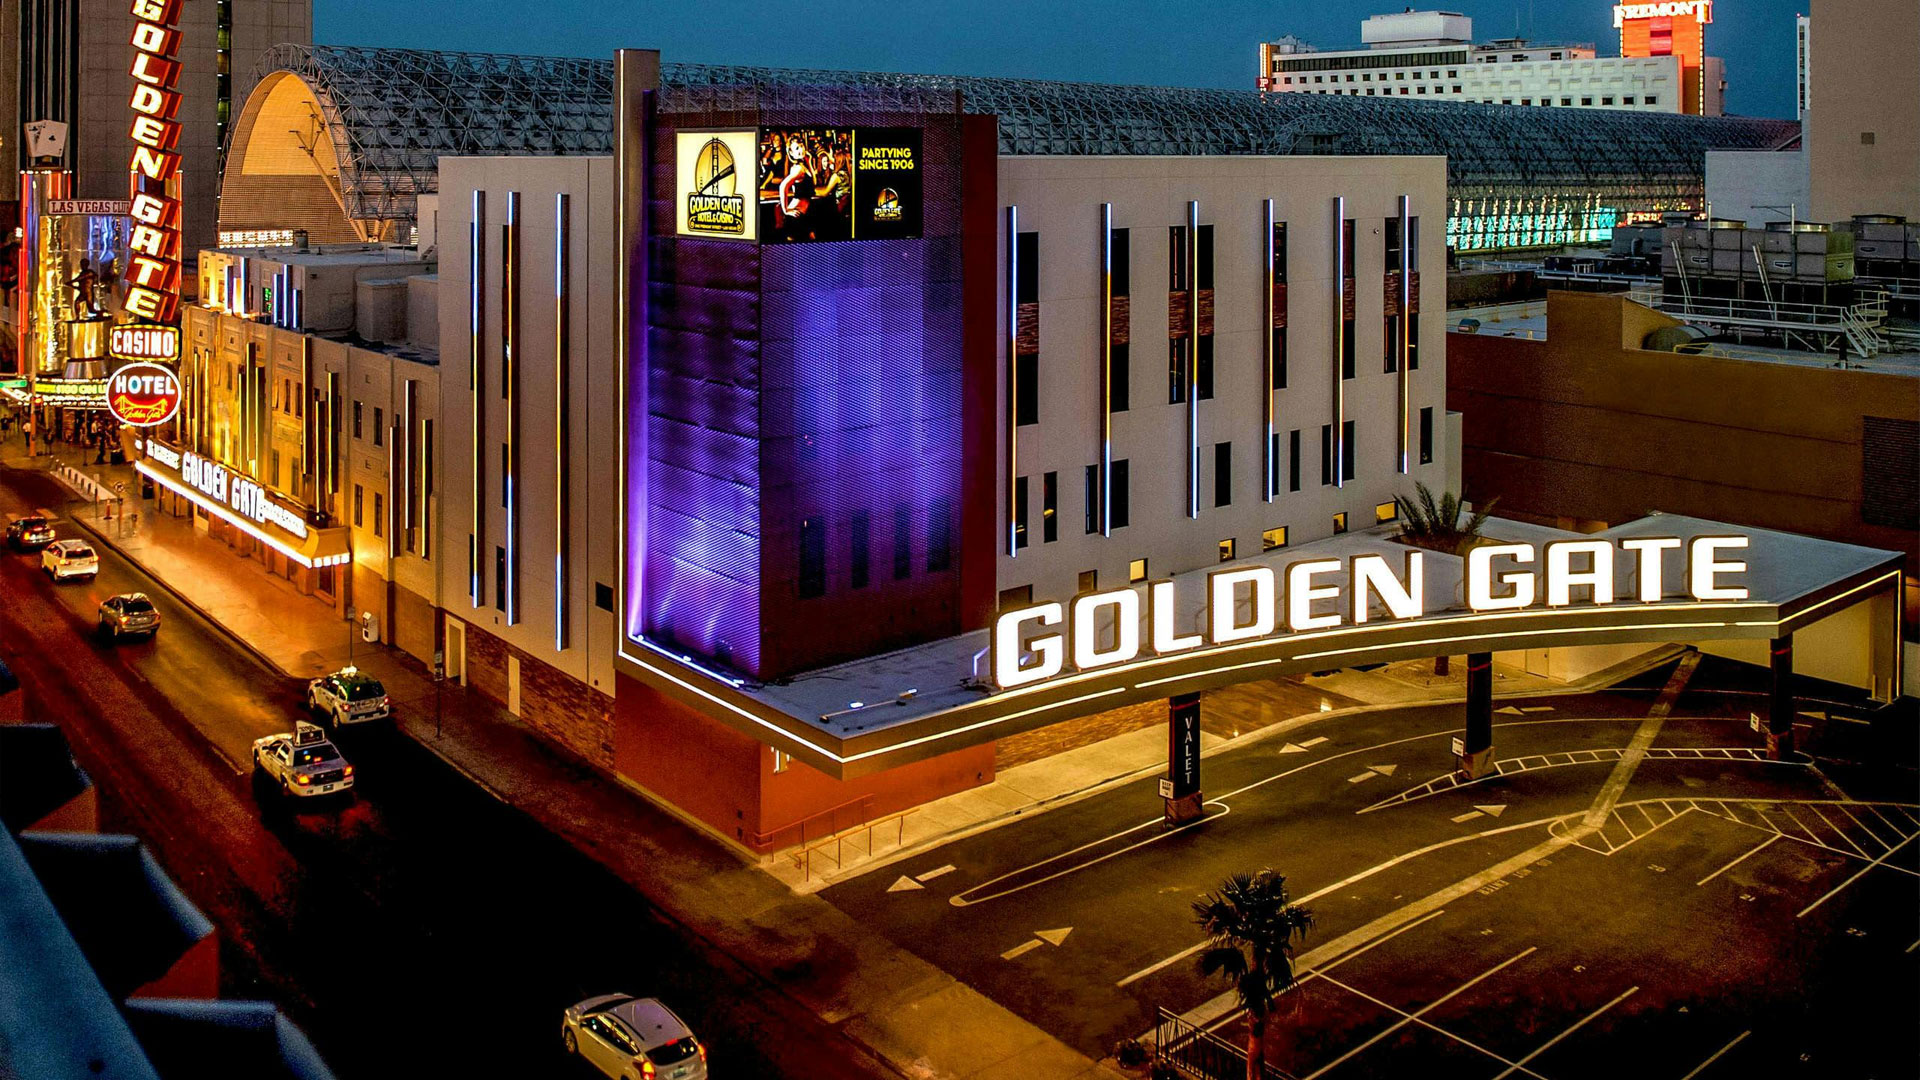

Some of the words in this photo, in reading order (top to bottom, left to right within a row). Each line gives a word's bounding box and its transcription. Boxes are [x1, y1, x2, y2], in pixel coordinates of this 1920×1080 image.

[1613, 0, 1710, 28] FREMONT
[131, 0, 166, 179] GOLDEN
[858, 159, 889, 170] SINCE
[890, 159, 914, 170] 1906
[861, 147, 912, 159] PARTYING
[51, 202, 74, 213] LAS
[76, 202, 110, 213] VEGAS
[690, 196, 720, 214] GOLDEN
[721, 197, 743, 218] GATE
[697, 212, 712, 222] HOTEL
[717, 212, 734, 223] CASINO
[125, 193, 164, 318] GATE
[112, 330, 175, 357] CASINO
[115, 375, 175, 395] HOTEL
[181, 451, 229, 504] GOLDEN
[231, 476, 265, 524] GATE
[994, 552, 1423, 688] GOLDEN
[1468, 537, 1749, 611] GATE
[1184, 716, 1193, 784] VALET
